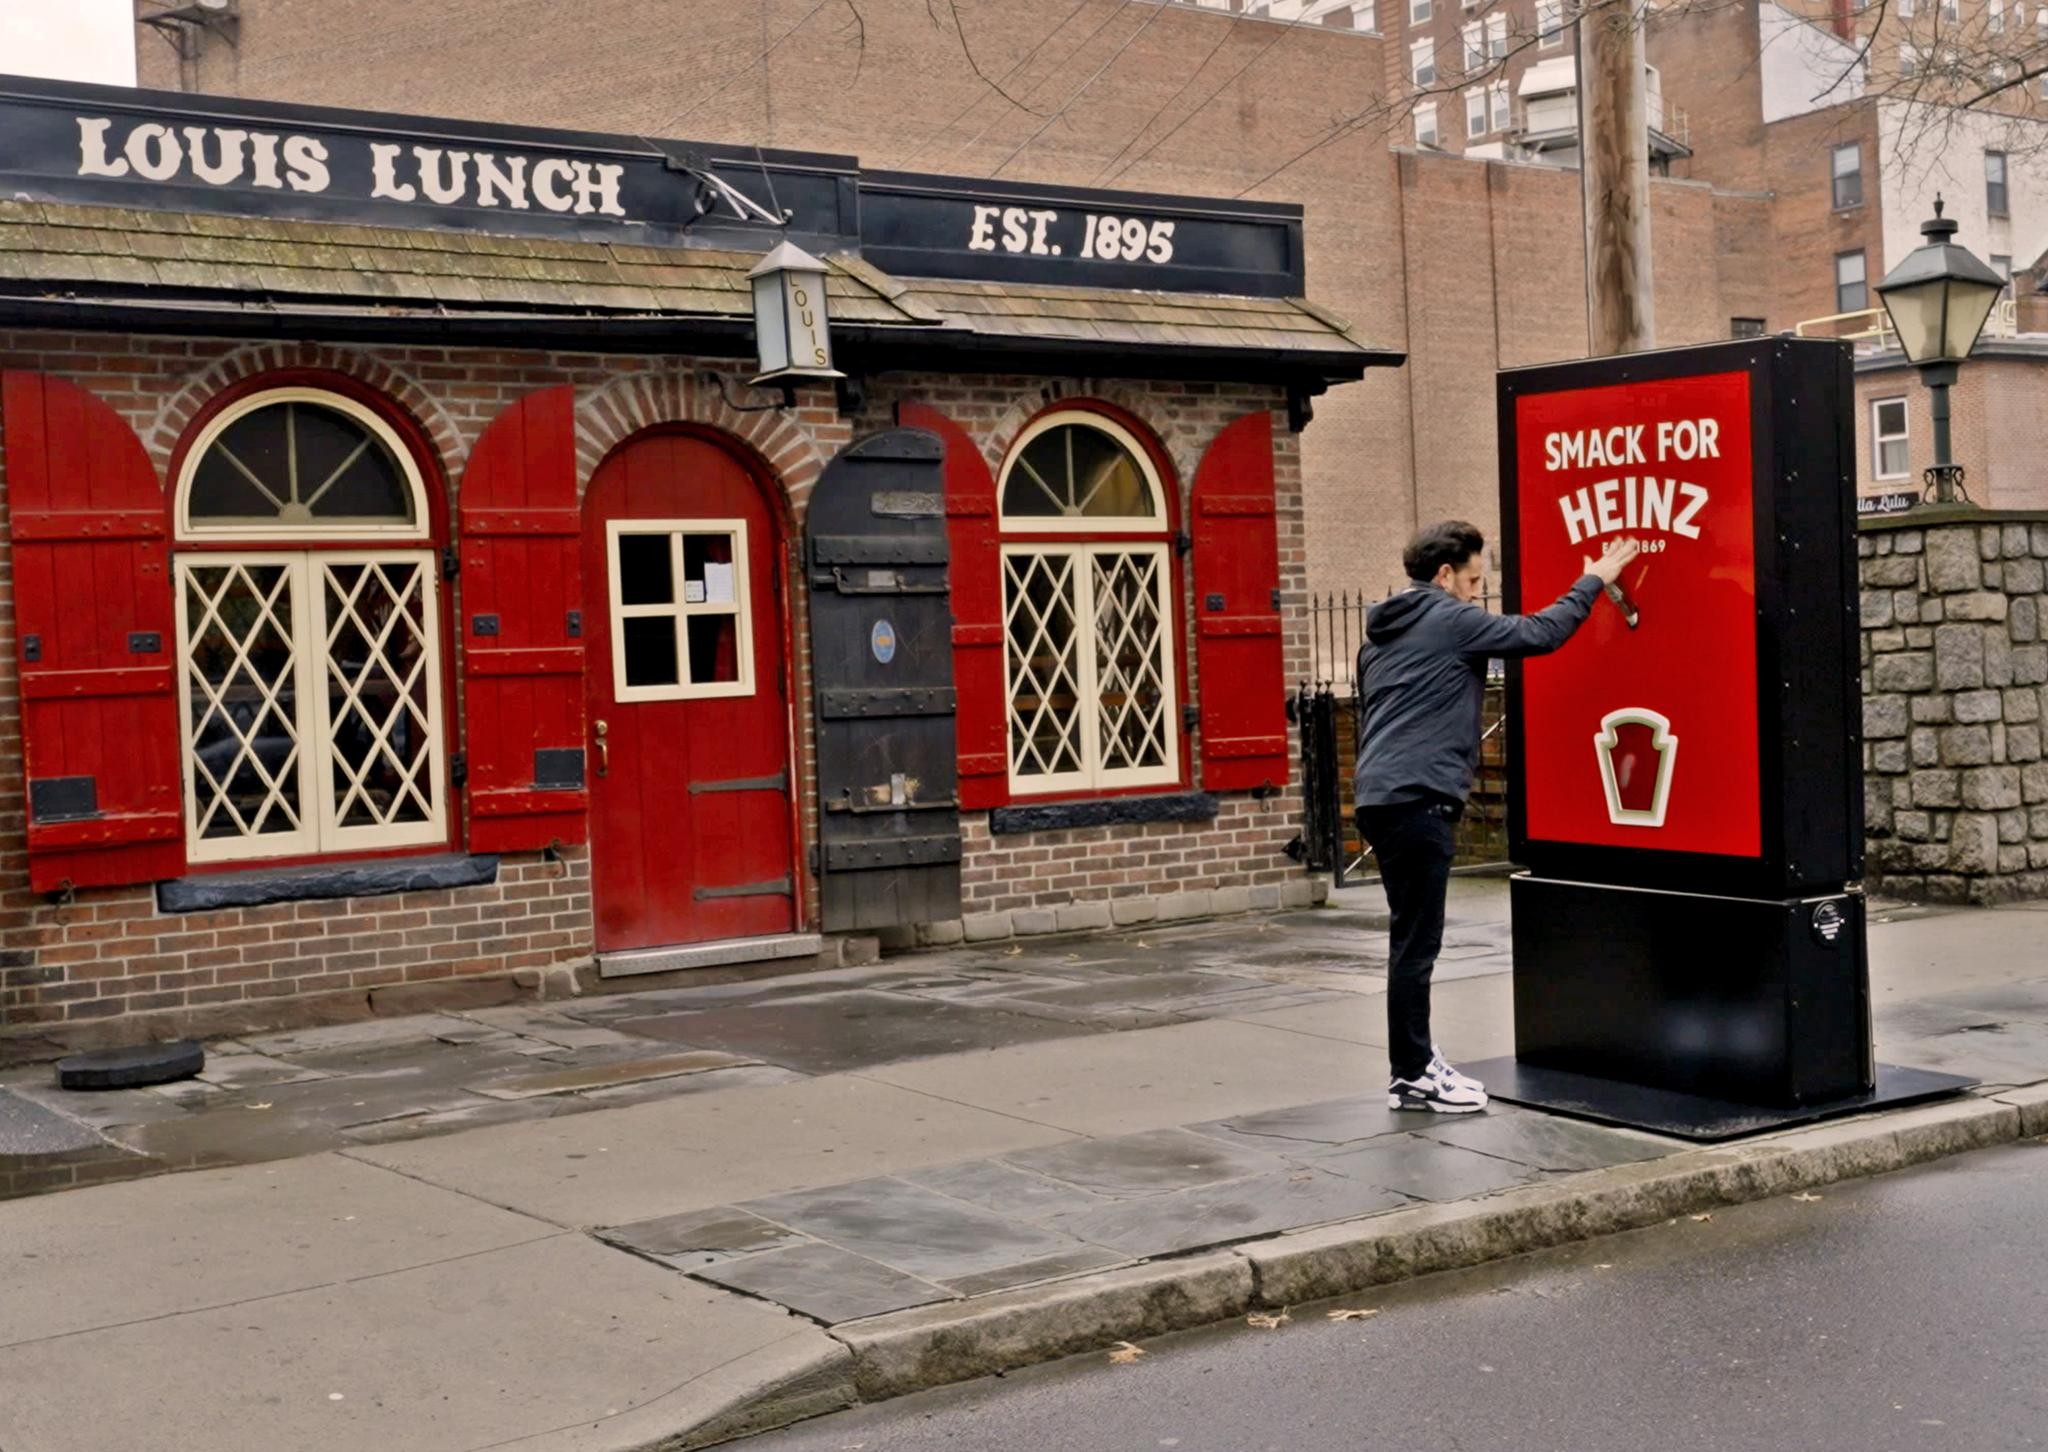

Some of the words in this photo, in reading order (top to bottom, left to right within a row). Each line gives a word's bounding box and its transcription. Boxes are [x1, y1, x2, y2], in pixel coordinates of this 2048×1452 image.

[76, 116, 331, 193] LOUIS
[369, 140, 626, 217] LUNCH
[968, 205, 1062, 256] EST.
[1080, 214, 1175, 264] 1895
[788, 271, 827, 366] LOUIS
[1545, 424, 1647, 472] SMACK
[1656, 418, 1721, 462] FOR
[1558, 475, 1710, 546] HEINZ
